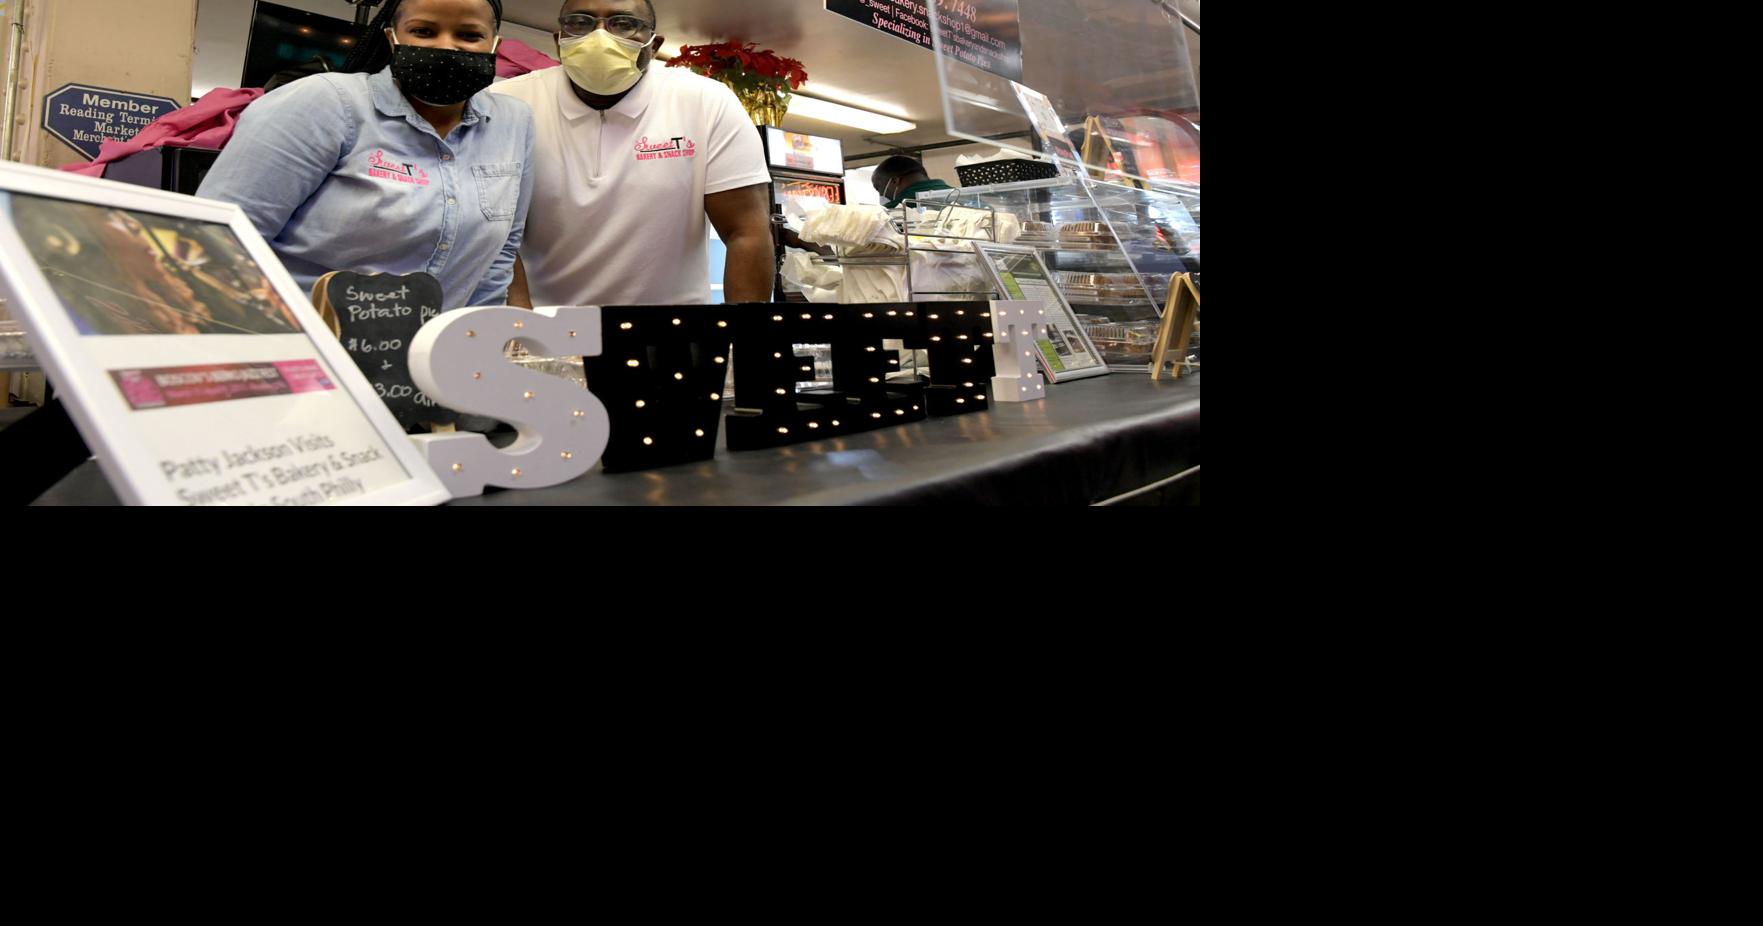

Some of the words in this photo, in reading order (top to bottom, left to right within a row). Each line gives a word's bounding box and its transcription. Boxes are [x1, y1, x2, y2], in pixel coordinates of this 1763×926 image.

[895, 8, 929, 30] Facebook:
[872, 12, 921, 43] Specializing
[923, 32, 931, 45] in
[954, 46, 977, 61] Potato
[60, 103, 114, 124] Reading
[83, 93, 159, 115] Member
[94, 121, 140, 136] Market
[636, 152, 657, 161] BAKERY
[663, 150, 681, 159] SNACK
[346, 285, 411, 302] Sweet
[347, 303, 412, 322] Potato
[160, 458, 221, 482] Patty
[222, 445, 293, 468] Jackson
[288, 434, 335, 452] Visits
[271, 462, 330, 485] Bakery
[340, 446, 384, 467] Snack
